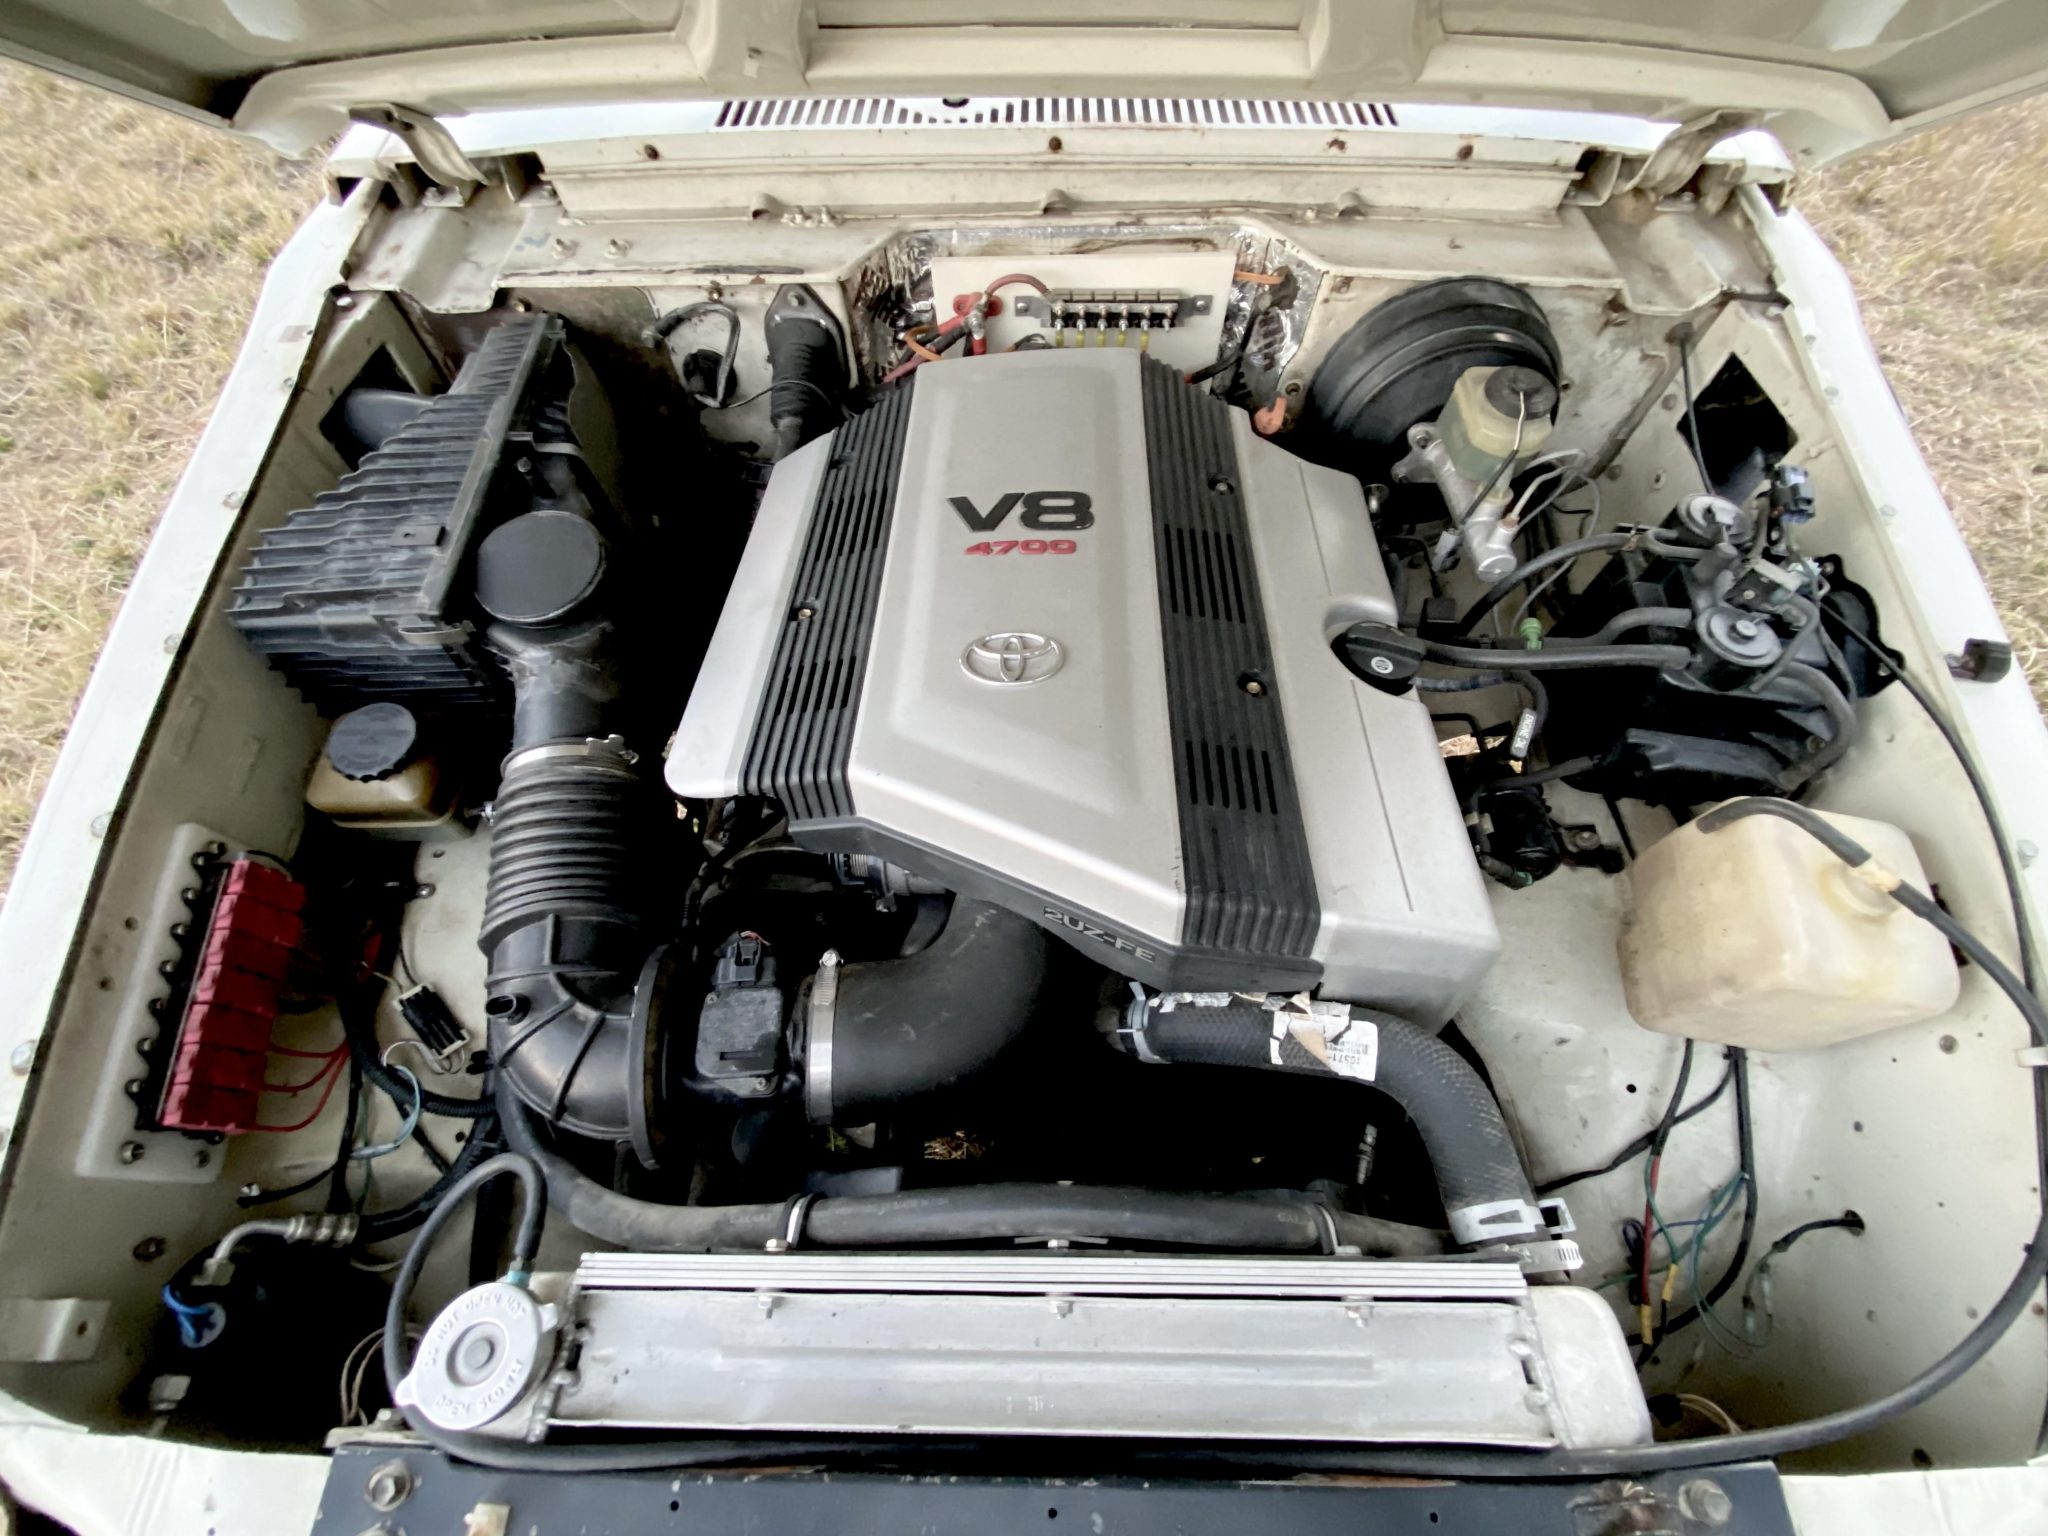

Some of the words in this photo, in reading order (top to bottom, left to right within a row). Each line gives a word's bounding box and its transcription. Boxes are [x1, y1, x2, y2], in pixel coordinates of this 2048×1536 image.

[946, 491, 1095, 533] V8
[964, 539, 1077, 556] 4700
[1044, 907, 1156, 964] 2UZ-FE
[465, 1291, 503, 1312] OPEN
[434, 1392, 473, 1417] OPEN
